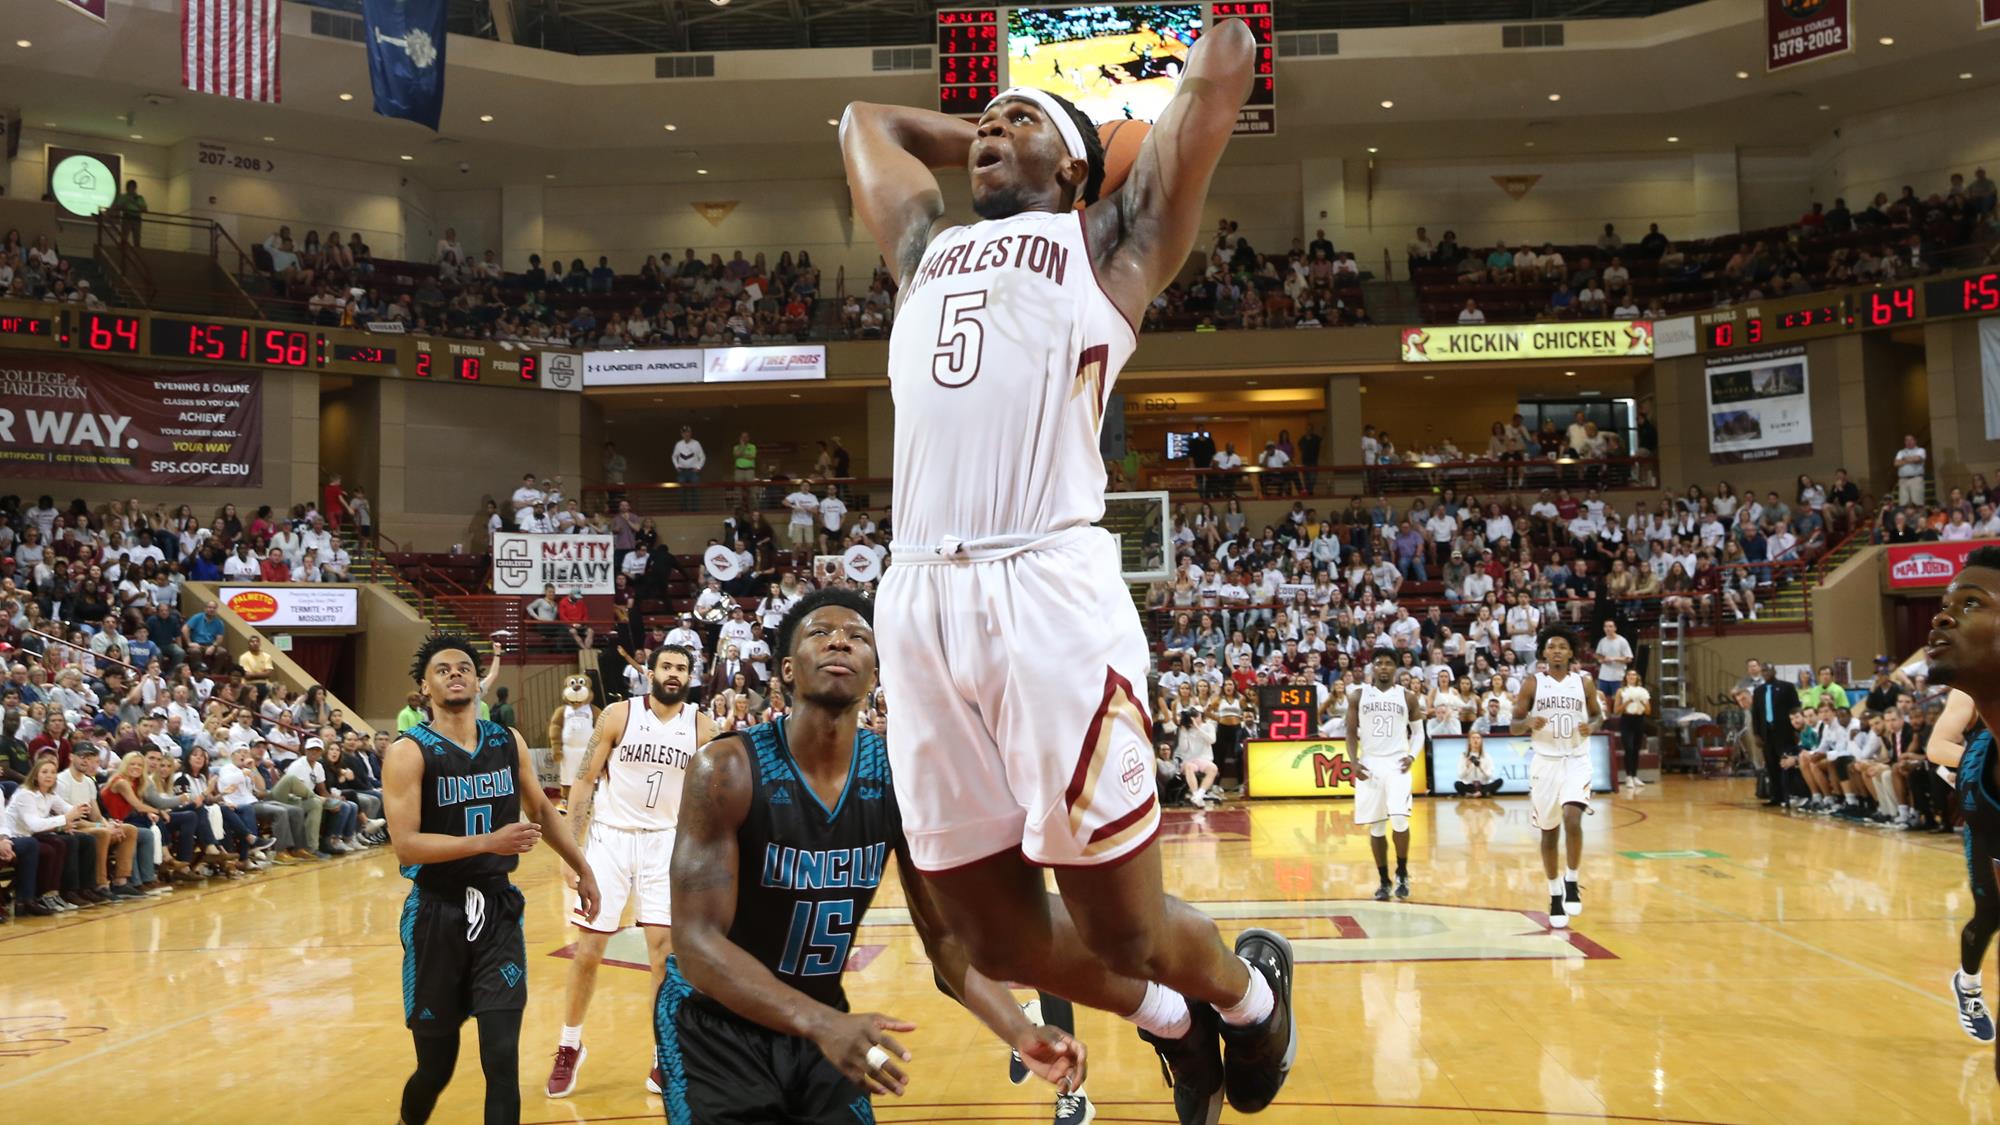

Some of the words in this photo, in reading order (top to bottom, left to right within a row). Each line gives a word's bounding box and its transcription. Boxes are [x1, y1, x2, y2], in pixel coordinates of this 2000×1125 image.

[1778, 26, 1802, 40] HEAD
[1804, 16, 1835, 33] COACH
[1772, 26, 1842, 60] 1979-2002
[1872, 288, 1914, 325] 64
[90, 316, 138, 350] 64
[190, 325, 248, 359] 1:51
[266, 330, 307, 366] 58
[932, 289, 988, 389] 5
[1533, 329, 1616, 350] CHICKEN
[1715, 322, 1733, 347] 10
[1749, 319, 1762, 343] 3
[416, 353, 431, 376] 2
[462, 357, 479, 380] 10
[520, 357, 535, 379] 2
[603, 363, 643, 372] UNDER
[647, 362, 698, 371] ARMOUR
[67, 375, 80, 386] of
[154, 382, 200, 392] EVENING
[203, 383, 210, 392] &
[212, 384, 250, 393] ONLINE
[163, 398, 194, 406] CLASSES
[196, 399, 206, 407] SO
[225, 400, 240, 408] CAN
[1145, 397, 1177, 410] BBQ
[179, 412, 226, 423] ACHIEVE
[25, 409, 139, 450] WAY.
[160, 428, 181, 436] YOUR
[183, 429, 211, 437] CAREER
[212, 430, 236, 438] GOALS
[173, 442, 203, 453] YOUR
[205, 443, 231, 453] WAY
[56, 454, 72, 462] GET
[74, 455, 97, 464] YOUR
[98, 456, 131, 465] DEGREE
[151, 460, 249, 475] SPS.COFC.EDU
[541, 541, 610, 561] NATTY
[541, 562, 610, 583] HEAVY
[233, 593, 274, 605] PALMETTO
[290, 606, 319, 614] TERMITE
[326, 606, 343, 614] PEST
[298, 614, 336, 622] MOSQUITO
[1281, 689, 1311, 705] 1:51
[1536, 695, 1583, 713] CHARLESTON
[1362, 700, 1405, 717] CHARLESTON
[1270, 709, 1308, 739] 23
[1372, 714, 1394, 738] 21
[1550, 711, 1574, 739] 10
[619, 743, 692, 770] CHARLESTO
[437, 765, 515, 807] UNCW
[646, 770, 664, 809] 1
[761, 841, 886, 890] UNCW
[778, 899, 854, 976] 15
